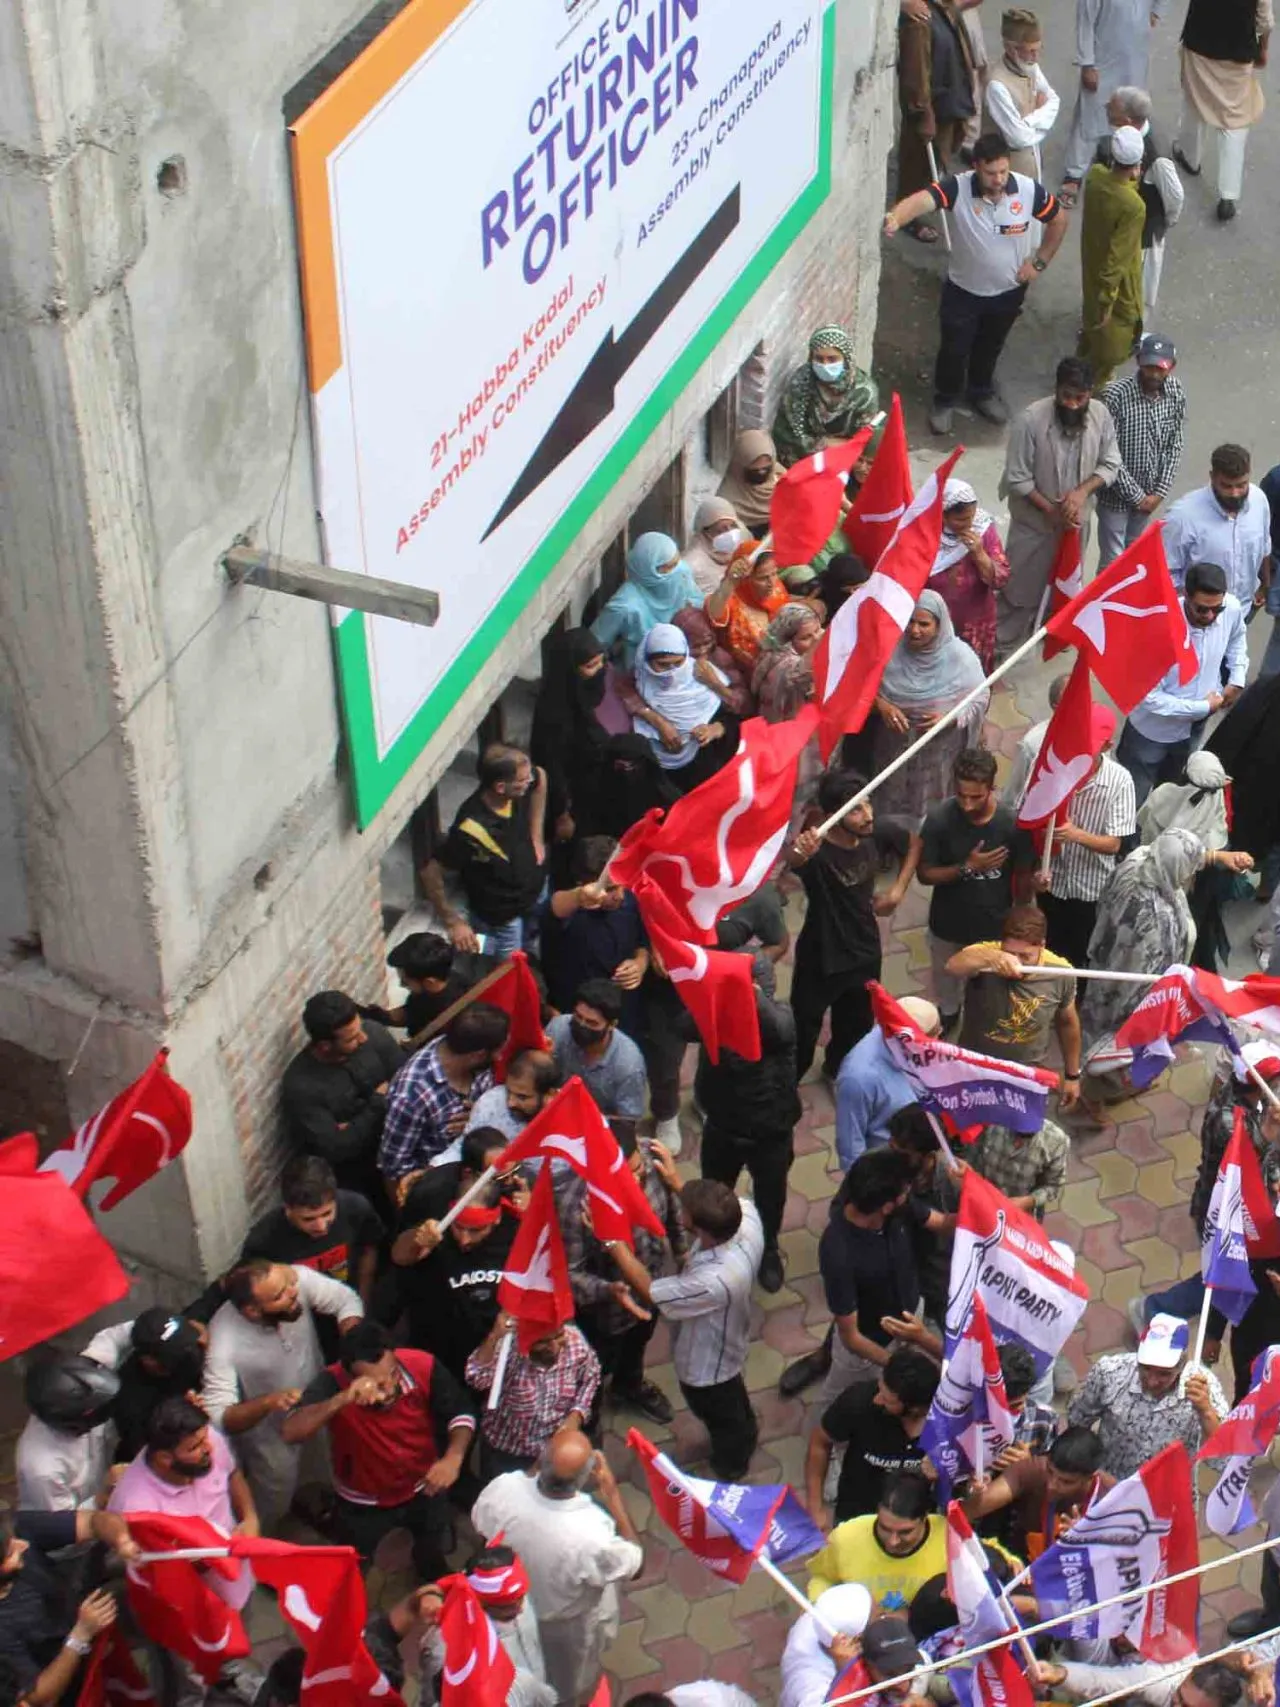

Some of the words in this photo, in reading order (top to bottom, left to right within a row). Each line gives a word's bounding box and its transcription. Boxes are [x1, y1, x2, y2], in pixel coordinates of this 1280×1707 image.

[522, 35, 699, 284] OFFICER
[528, 18, 610, 135] OFFICE
[636, 139, 713, 248] Assembly
[715, 17, 811, 146] Constituency
[671, 19, 782, 168] 23-Chanapora
[396, 425, 488, 554] Assembly
[491, 273, 607, 430] Constituency
[430, 347, 519, 470] 21-Habba
[522, 274, 574, 354] Kadal
[979, 1265, 1018, 1300] APNI
[1013, 1286, 1063, 1327] PARTY
